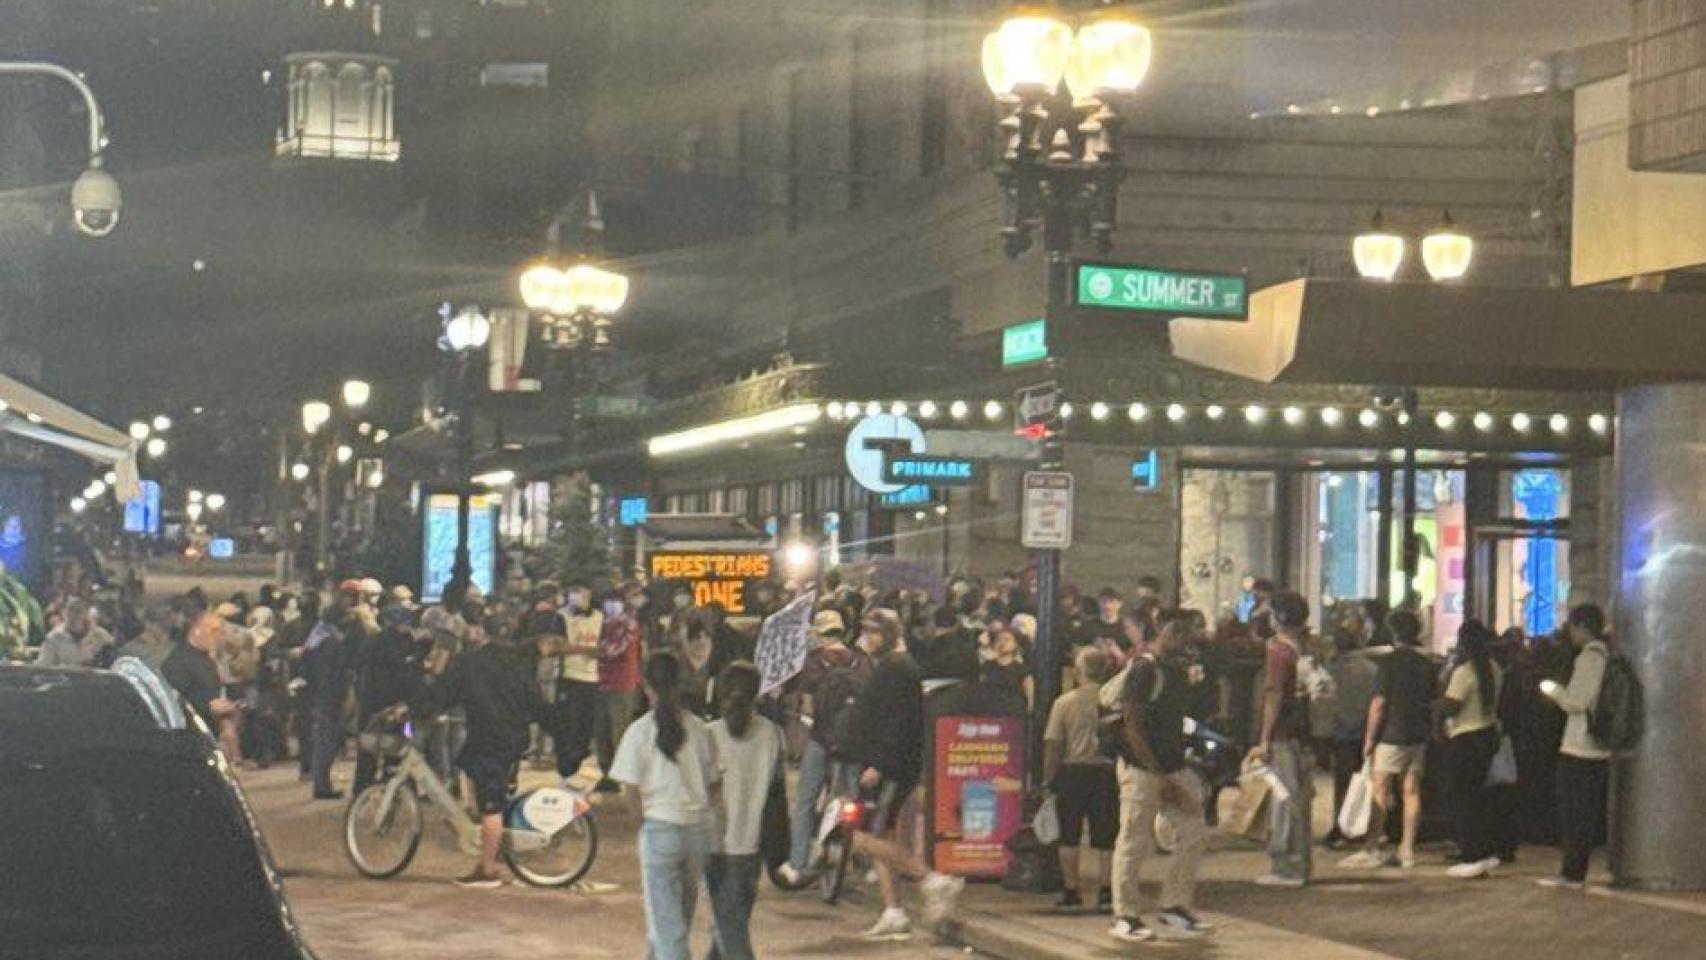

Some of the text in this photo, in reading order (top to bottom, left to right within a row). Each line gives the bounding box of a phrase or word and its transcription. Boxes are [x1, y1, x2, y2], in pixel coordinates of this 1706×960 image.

[1122, 273, 1214, 306] SUMMER
[892, 460, 972, 477] PRIMARK
[652, 555, 770, 578] PEDESTRIANS
